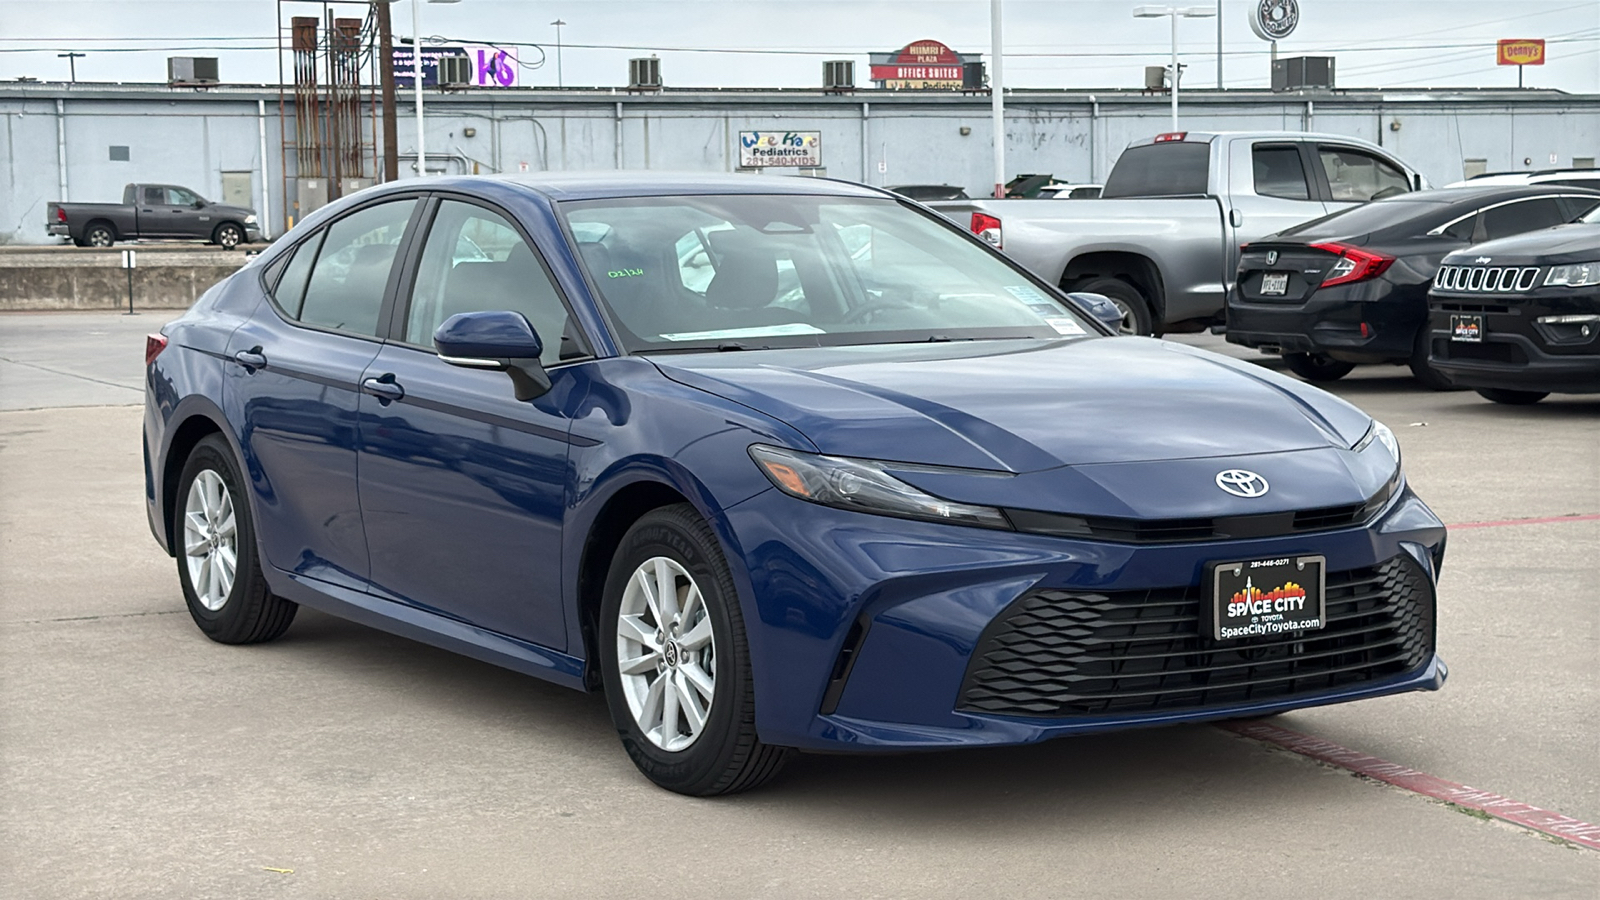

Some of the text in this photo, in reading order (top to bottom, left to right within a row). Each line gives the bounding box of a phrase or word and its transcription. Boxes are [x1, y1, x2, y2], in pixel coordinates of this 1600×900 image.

[917, 55, 938, 63] PLAZA
[897, 67, 958, 78] OFFICE SUITES
[742, 131, 818, 148] Wee Kare
[753, 147, 809, 156] Pediatrics
[746, 156, 817, 166] 281-540-KIDS
[1227, 596, 1306, 618] SPACE CITY
[1261, 614, 1284, 622] TOYOTA
[1221, 618, 1320, 638] SpaceCityToyota.com
